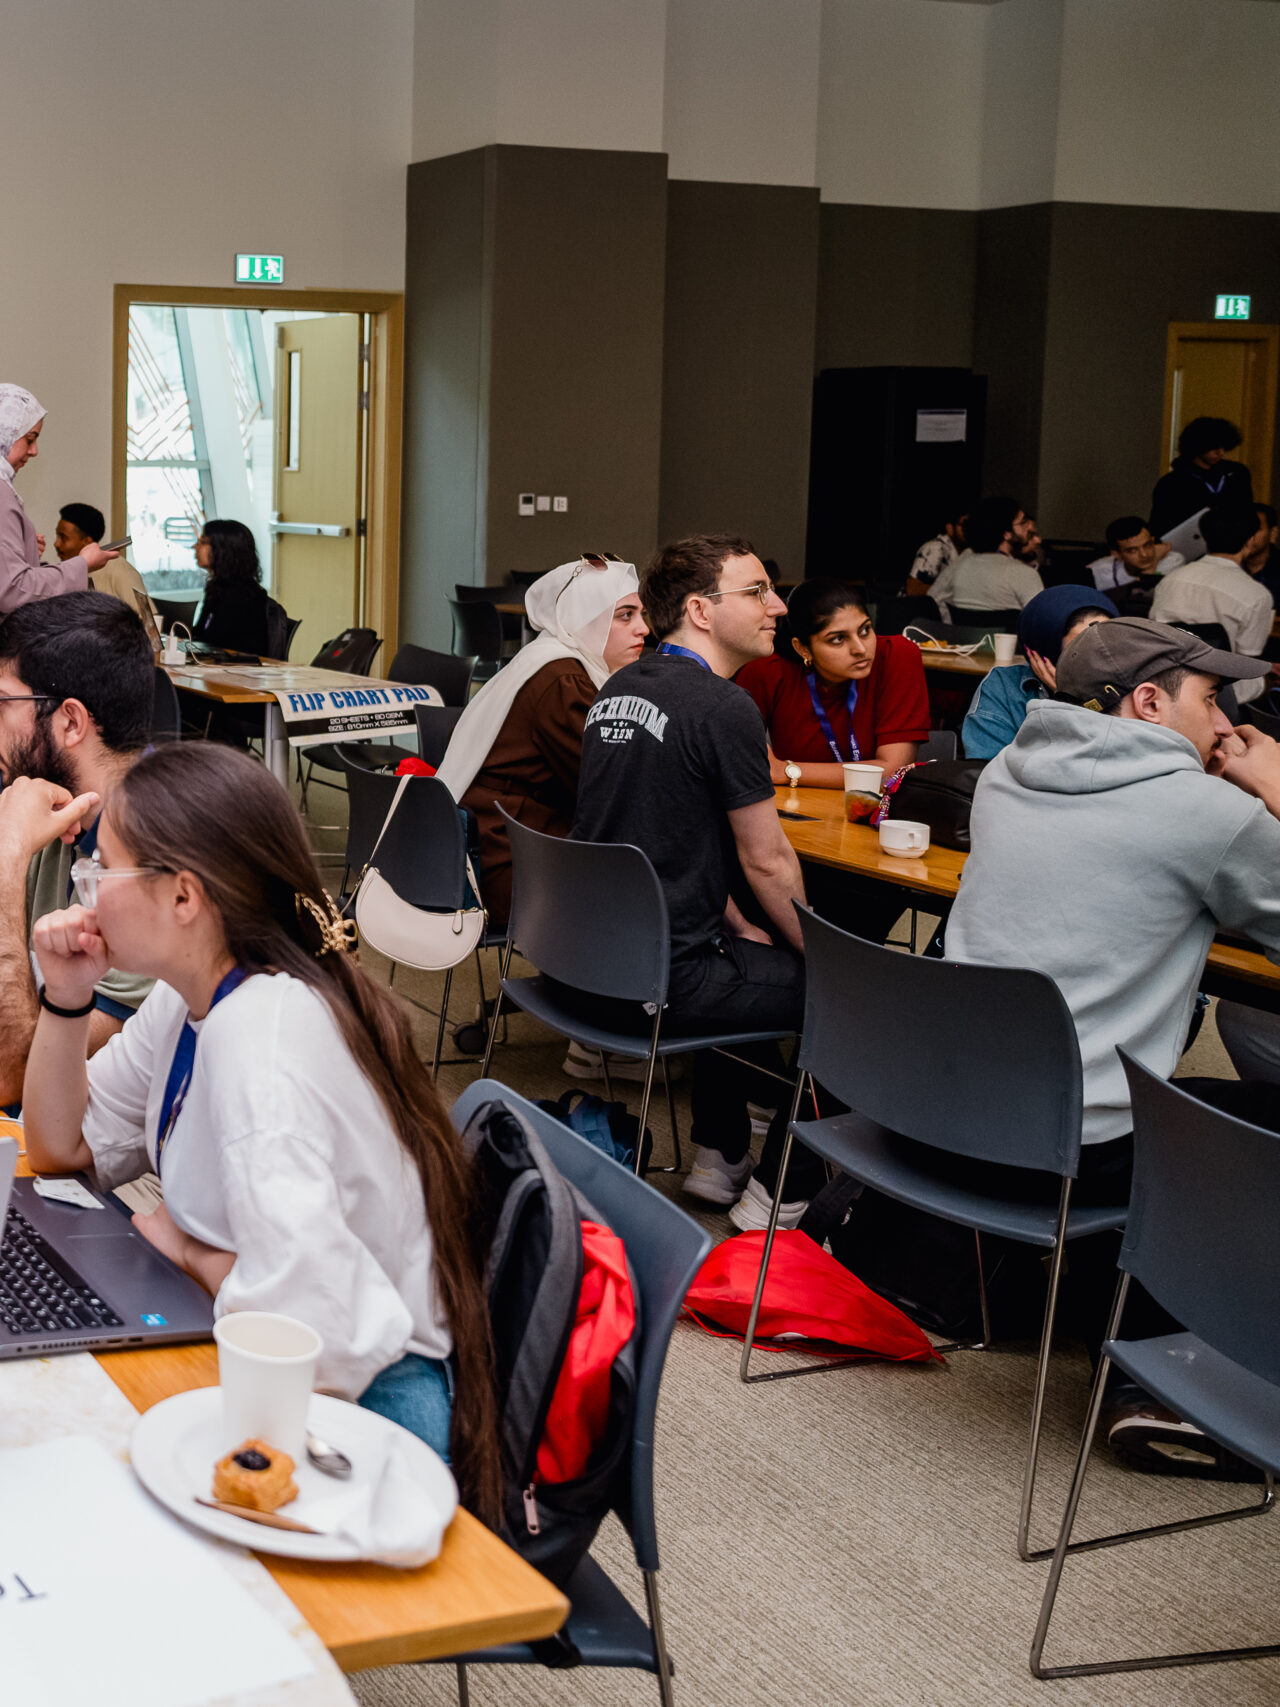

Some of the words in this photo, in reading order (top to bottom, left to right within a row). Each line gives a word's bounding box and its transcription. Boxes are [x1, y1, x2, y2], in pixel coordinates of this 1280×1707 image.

[287, 692, 326, 713] FLIP
[329, 688, 391, 709] CHART
[391, 687, 430, 703] PAD
[340, 715, 370, 724] SHEETS
